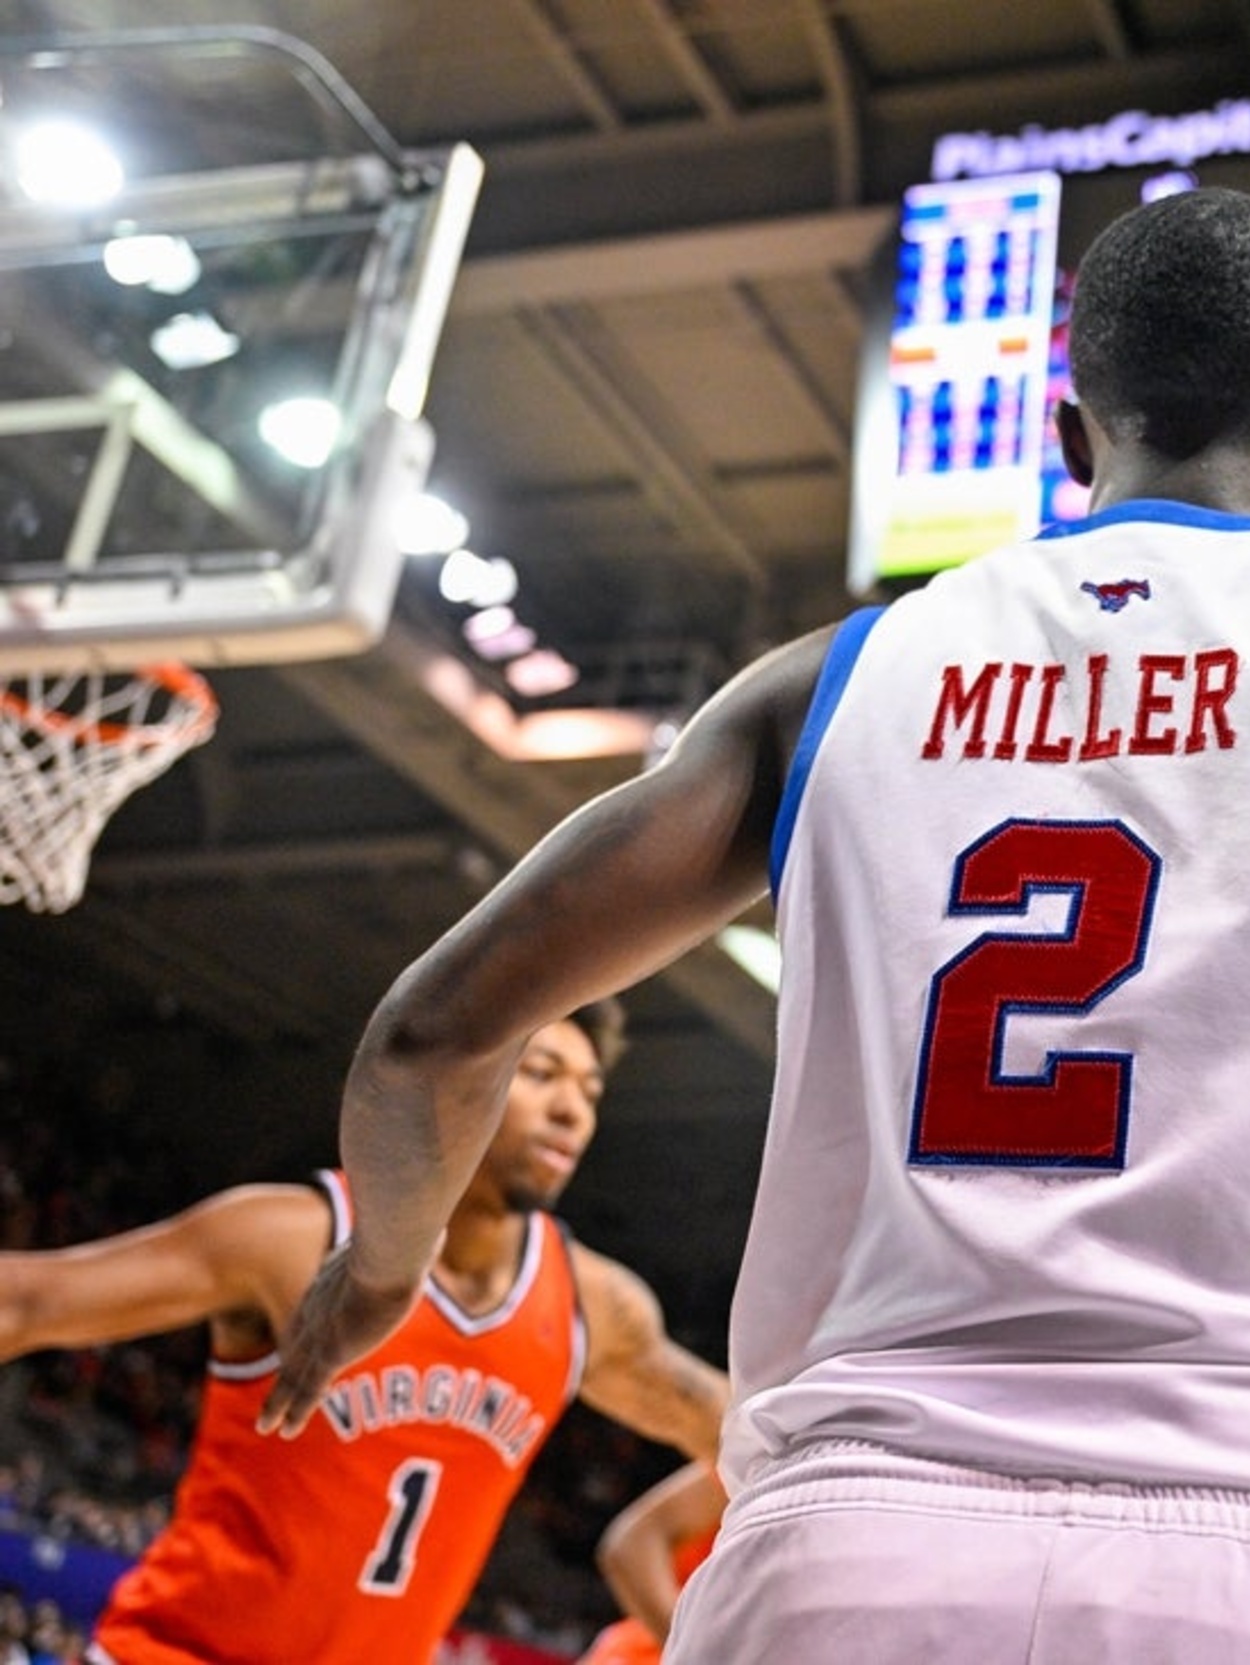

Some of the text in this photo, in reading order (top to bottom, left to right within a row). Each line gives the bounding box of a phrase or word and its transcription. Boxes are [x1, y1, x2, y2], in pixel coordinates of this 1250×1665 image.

[920, 648, 1238, 763] MILLER
[907, 817, 1163, 1169] 2
[322, 1363, 546, 1470] VIRGINIA
[357, 1456, 443, 1597] 1
